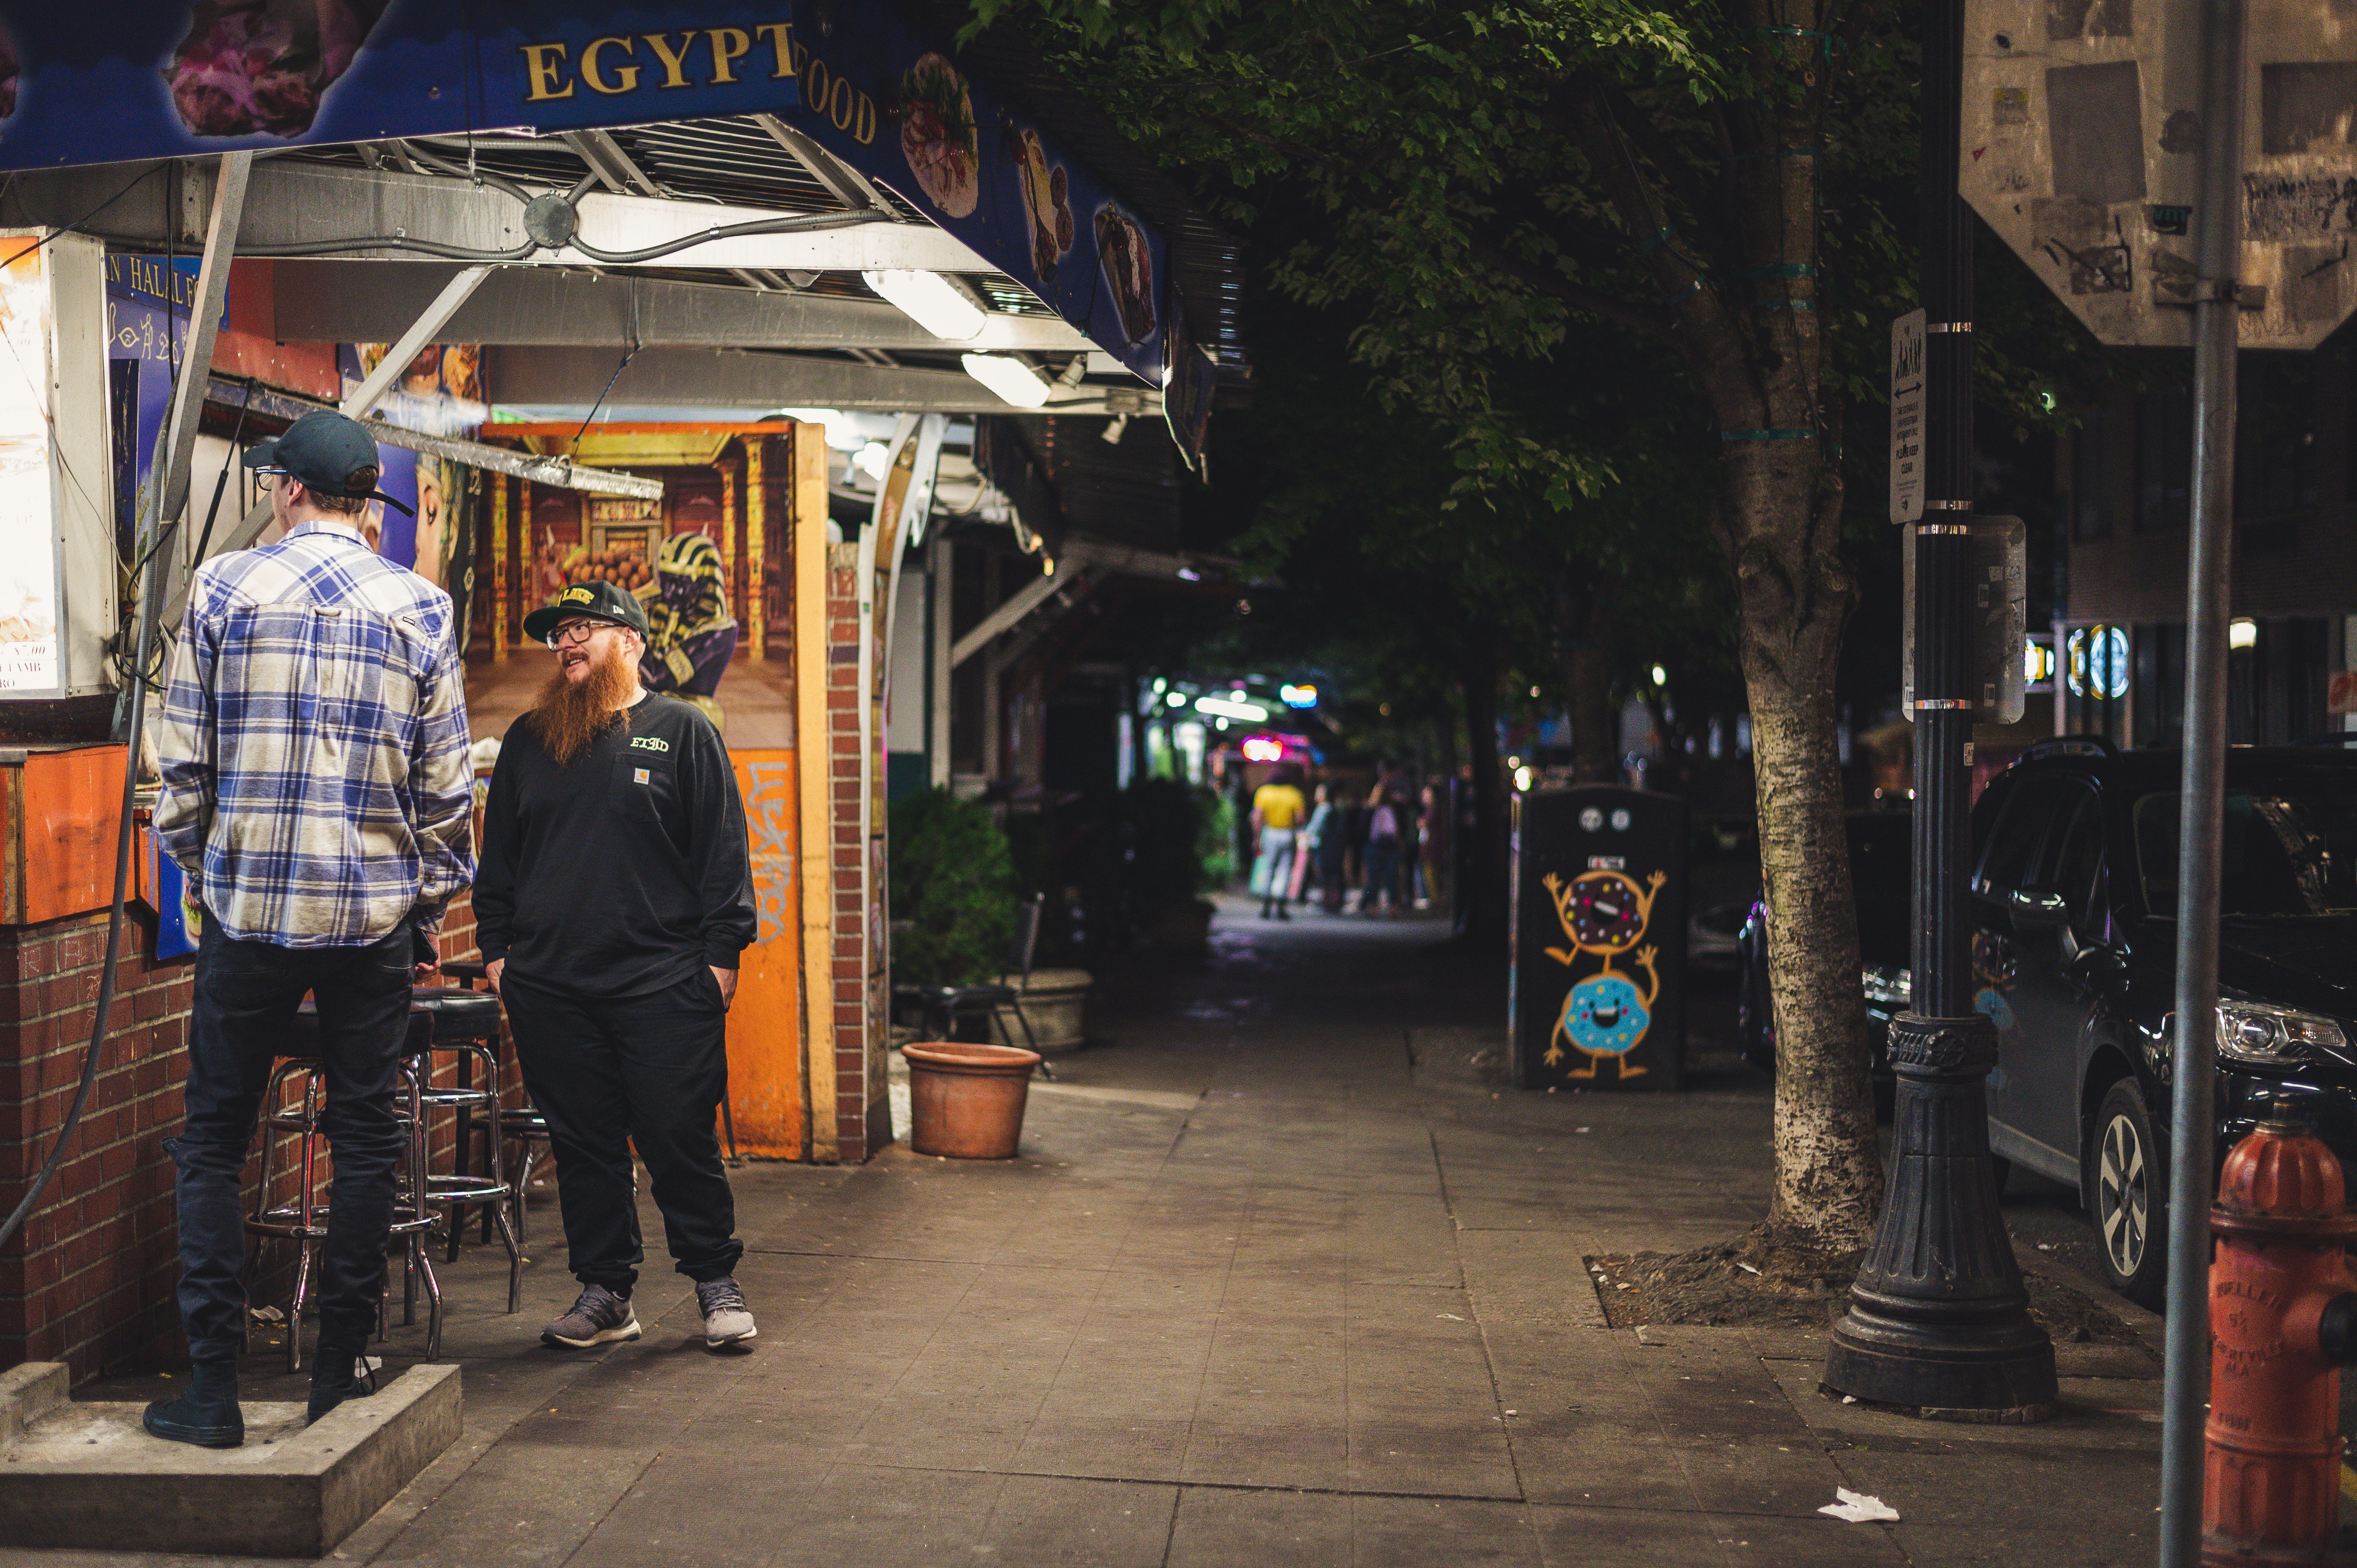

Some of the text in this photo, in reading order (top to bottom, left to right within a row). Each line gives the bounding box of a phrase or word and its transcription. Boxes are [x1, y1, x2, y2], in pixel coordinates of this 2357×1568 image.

[519, 24, 796, 101] EGYPT
[1910, 445, 1918, 456] KEEP
[1902, 462, 1912, 474] CLEAR
